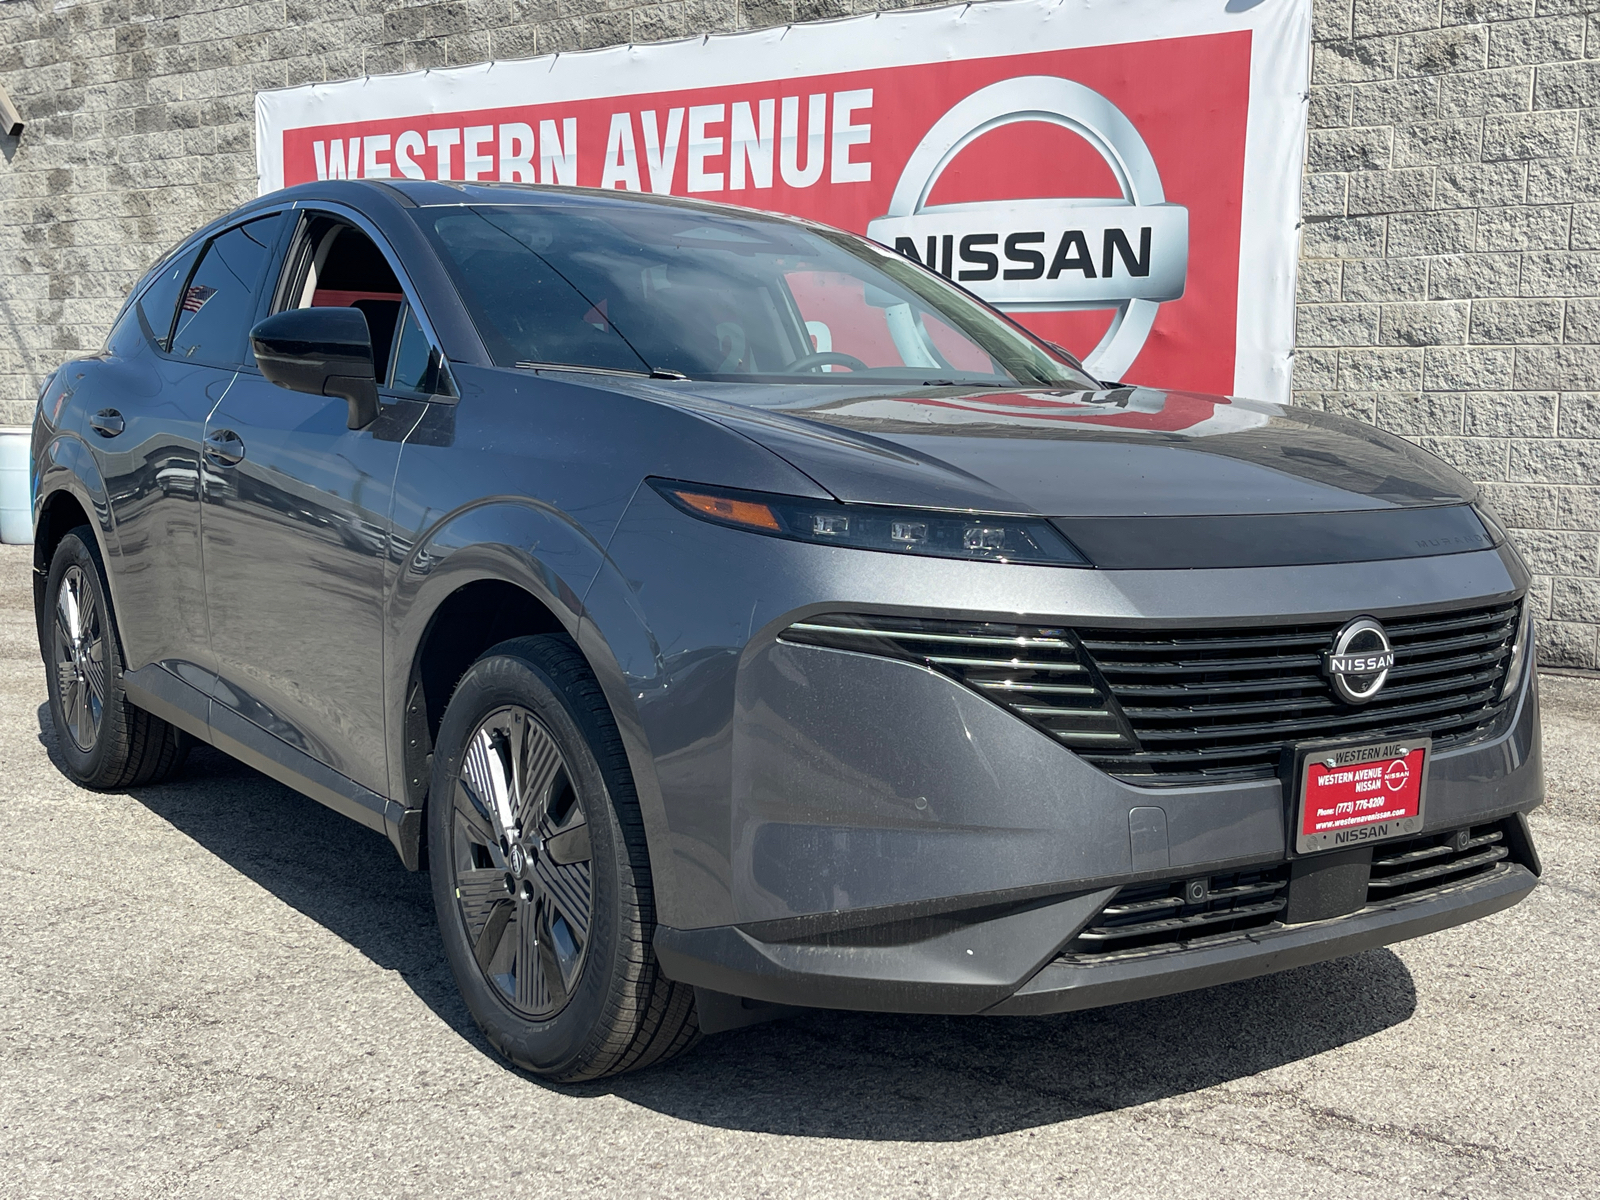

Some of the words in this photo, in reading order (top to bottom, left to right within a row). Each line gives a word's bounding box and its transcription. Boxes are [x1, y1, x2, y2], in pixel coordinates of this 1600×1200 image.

[313, 117, 577, 186] WESTERN
[602, 88, 874, 194] AVENUE
[895, 226, 1152, 282] NISSAN
[1415, 534, 1484, 548] MURANO
[1331, 653, 1394, 671] NISSAN
[1335, 747, 1381, 764] WESTERN
[1318, 772, 1354, 786] WESTERN
[1354, 767, 1383, 782] AVENUE
[1384, 771, 1410, 780] NISSAN
[1355, 779, 1382, 793] NISSAN
[1316, 807, 1335, 817] Phone:
[1335, 801, 1354, 816] (773)
[1355, 796, 1385, 811] 776-8200
[1315, 808, 1406, 830] www.westernavenissan.com
[1335, 823, 1388, 845] NISSAN
